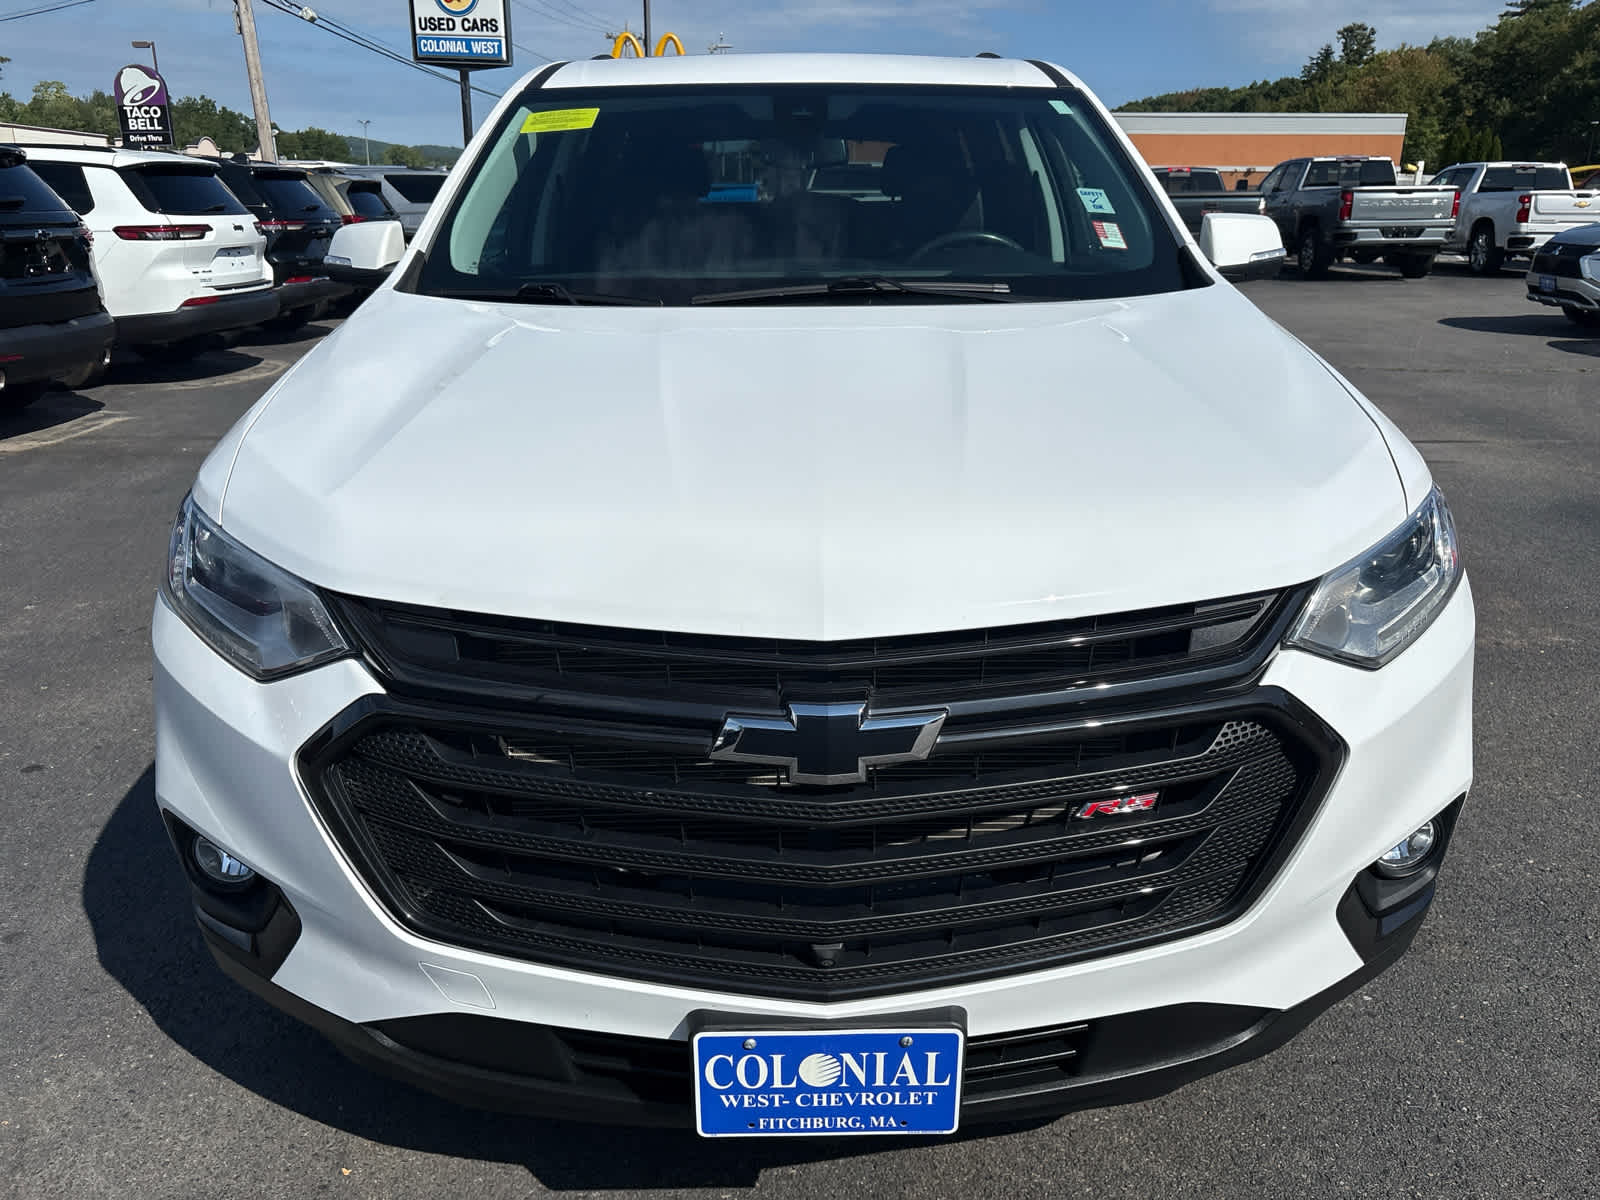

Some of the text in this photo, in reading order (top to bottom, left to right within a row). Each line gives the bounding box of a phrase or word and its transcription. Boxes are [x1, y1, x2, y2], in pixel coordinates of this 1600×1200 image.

[418, 16, 499, 32] USED CARS
[420, 39, 500, 54] COLONIAL WEST
[123, 106, 161, 118] TACO
[128, 118, 163, 130] BELL
[129, 134, 163, 142] Drive Thru
[704, 1052, 951, 1090] COLONIAL
[720, 1091, 938, 1108] WEST- CHEVROLET
[758, 1115, 897, 1130] FITCHBURG, MA
